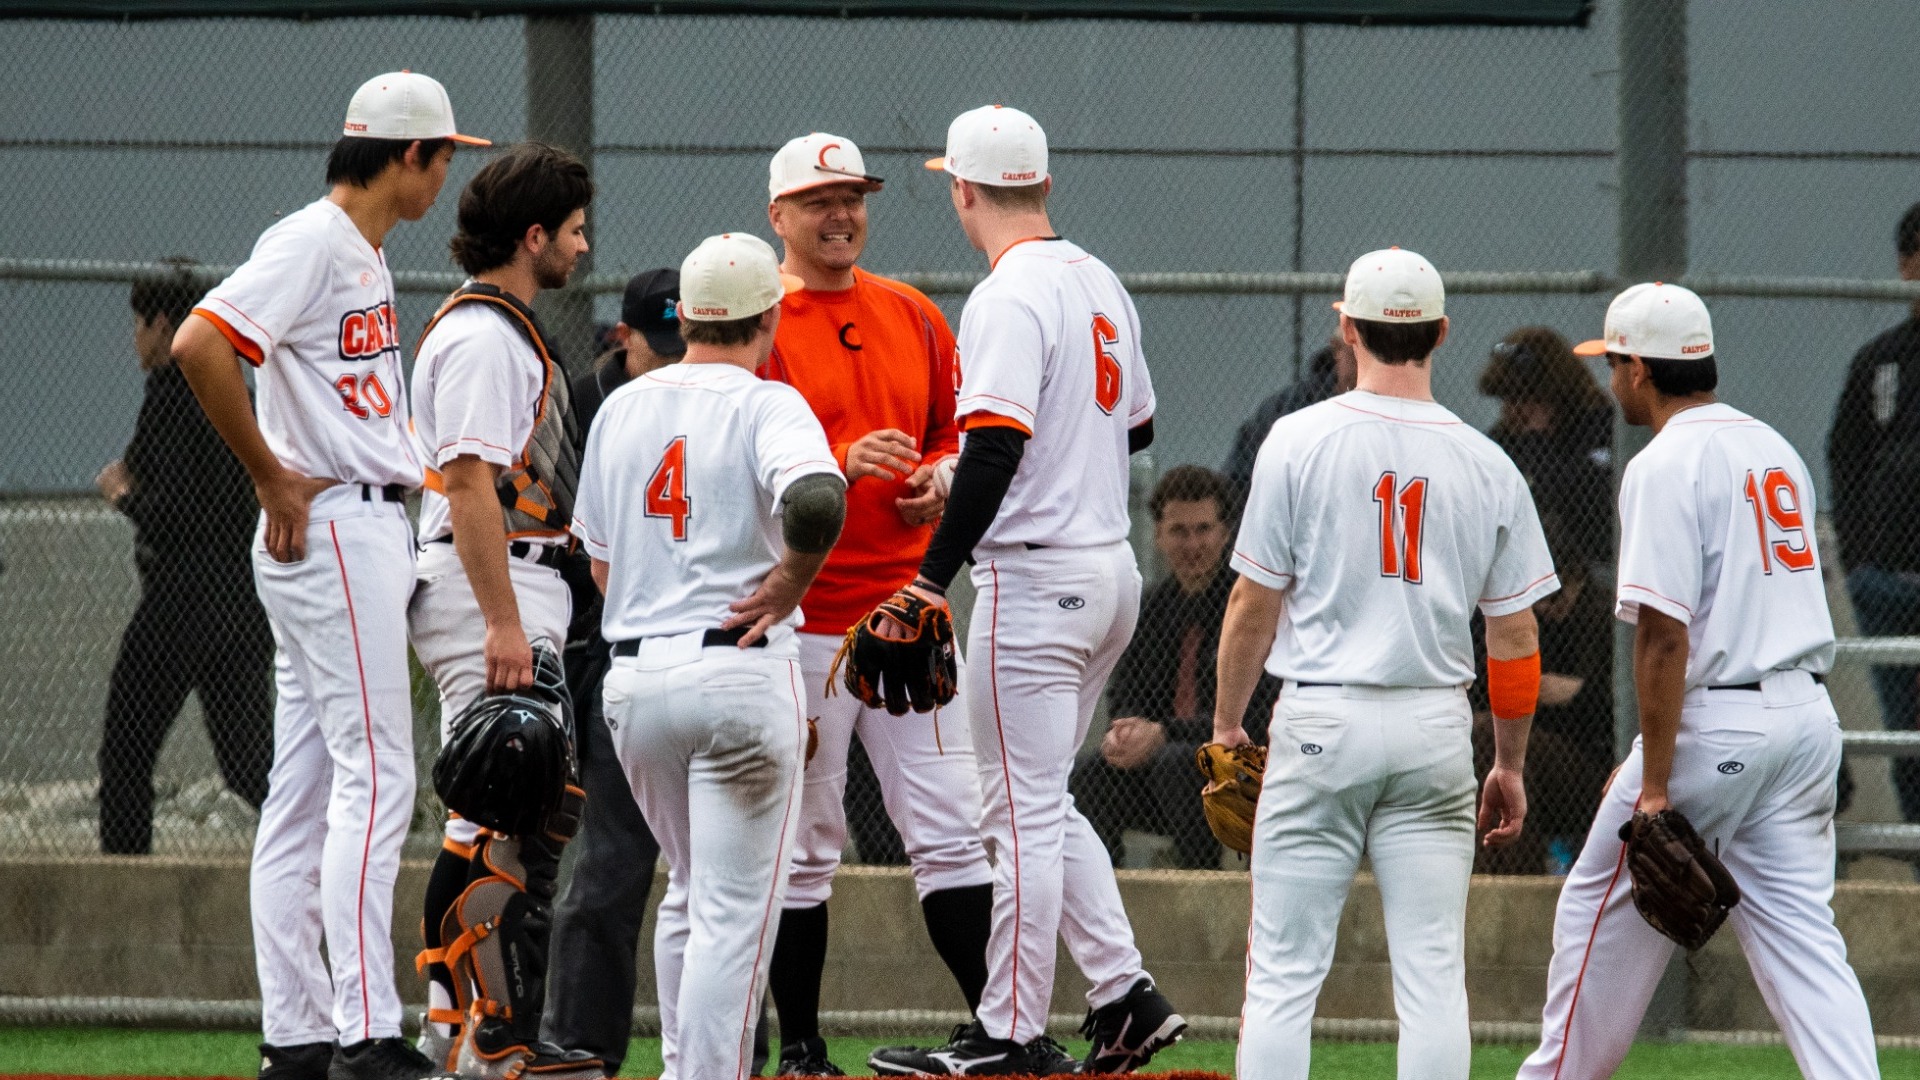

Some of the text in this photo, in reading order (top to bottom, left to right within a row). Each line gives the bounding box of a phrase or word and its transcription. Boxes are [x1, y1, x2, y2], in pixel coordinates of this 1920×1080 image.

[819, 143, 846, 172] C
[1002, 171, 1037, 181] CALTECH
[692, 306, 729, 317] CALTECH
[1383, 308, 1422, 318] CALTECH
[838, 321, 864, 352] C
[1681, 343, 1711, 354] CALTECH
[1091, 312, 1124, 416] 6
[335, 369, 393, 420] 20
[643, 435, 692, 542] 4
[1372, 470, 1429, 585] 11
[1743, 467, 1816, 576] 19
